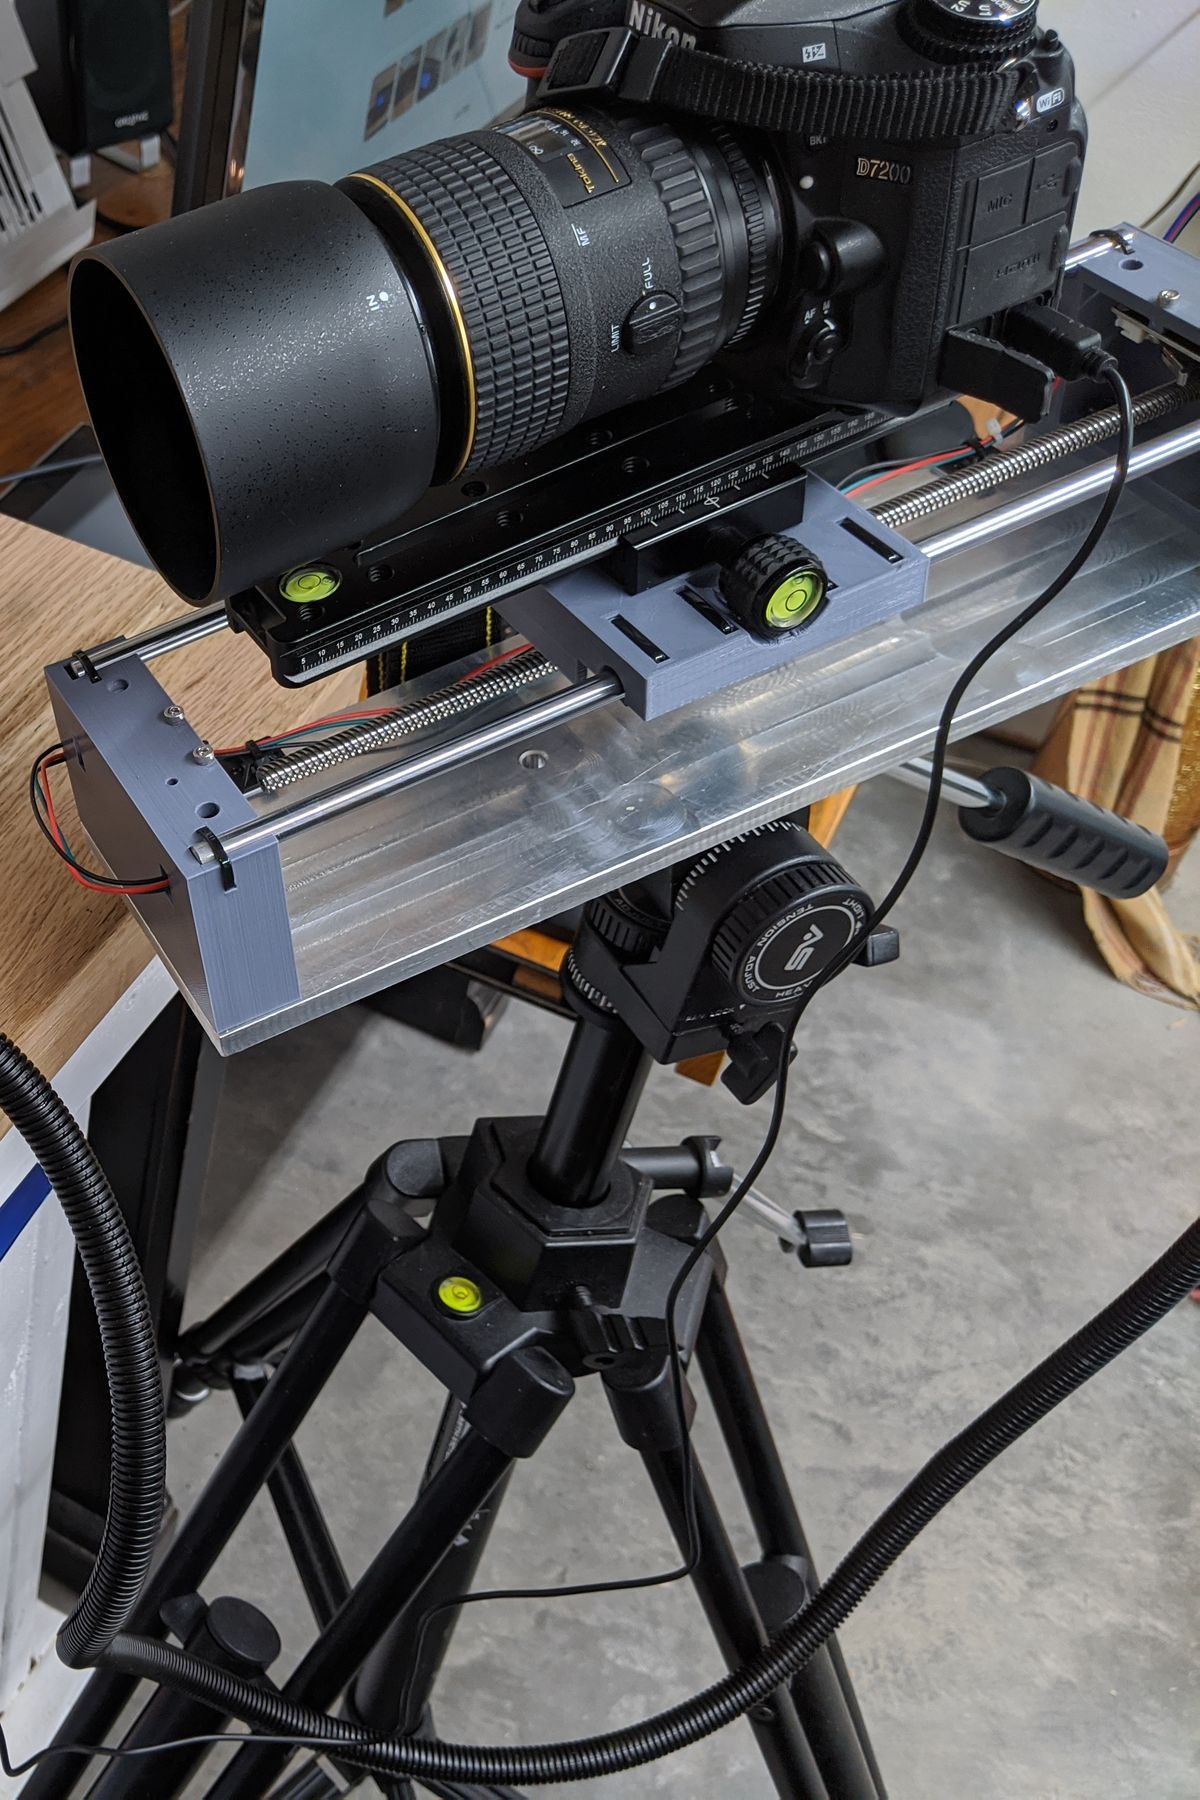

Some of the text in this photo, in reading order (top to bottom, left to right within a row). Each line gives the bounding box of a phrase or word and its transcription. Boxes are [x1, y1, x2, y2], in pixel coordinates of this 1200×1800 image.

[979, 5, 992, 16] U1
[629, 0, 697, 50] Nikon
[566, 152, 595, 194] Tokina
[856, 157, 911, 185] D7200
[576, 227, 590, 247] MF
[642, 257, 654, 289] FULL
[804, 308, 816, 321] AF
[611, 324, 620, 353] LIMIT
[318, 649, 326, 658] 10
[336, 641, 344, 649] 15
[354, 632, 362, 641] 20
[372, 625, 381, 633] 25
[391, 617, 399, 625] 30
[409, 609, 417, 617] 35
[427, 601, 436, 610] 40
[446, 593, 454, 601] 45
[463, 586, 472, 594] 50
[481, 578, 490, 586] 55
[499, 570, 508, 578] 60
[517, 562, 525, 570] 65
[535, 555, 543, 563] 70
[553, 547, 560, 555] 75
[570, 540, 578, 548] 80
[588, 532, 596, 540] 85
[606, 524, 614, 532] 90
[640, 508, 651, 517] 100
[658, 501, 668, 509] 105
[676, 493, 686, 502] 110
[693, 486, 704, 494] 115
[710, 478, 722, 487] 120
[728, 470, 739, 480] 125
[744, 463, 756, 472] 130
[762, 456, 774, 465] 135
[779, 448, 790, 457] 140
[842, 897, 865, 919] LIGHT
[744, 903, 814, 993] TENSION ADJUST
[775, 980, 814, 998] HEAV
